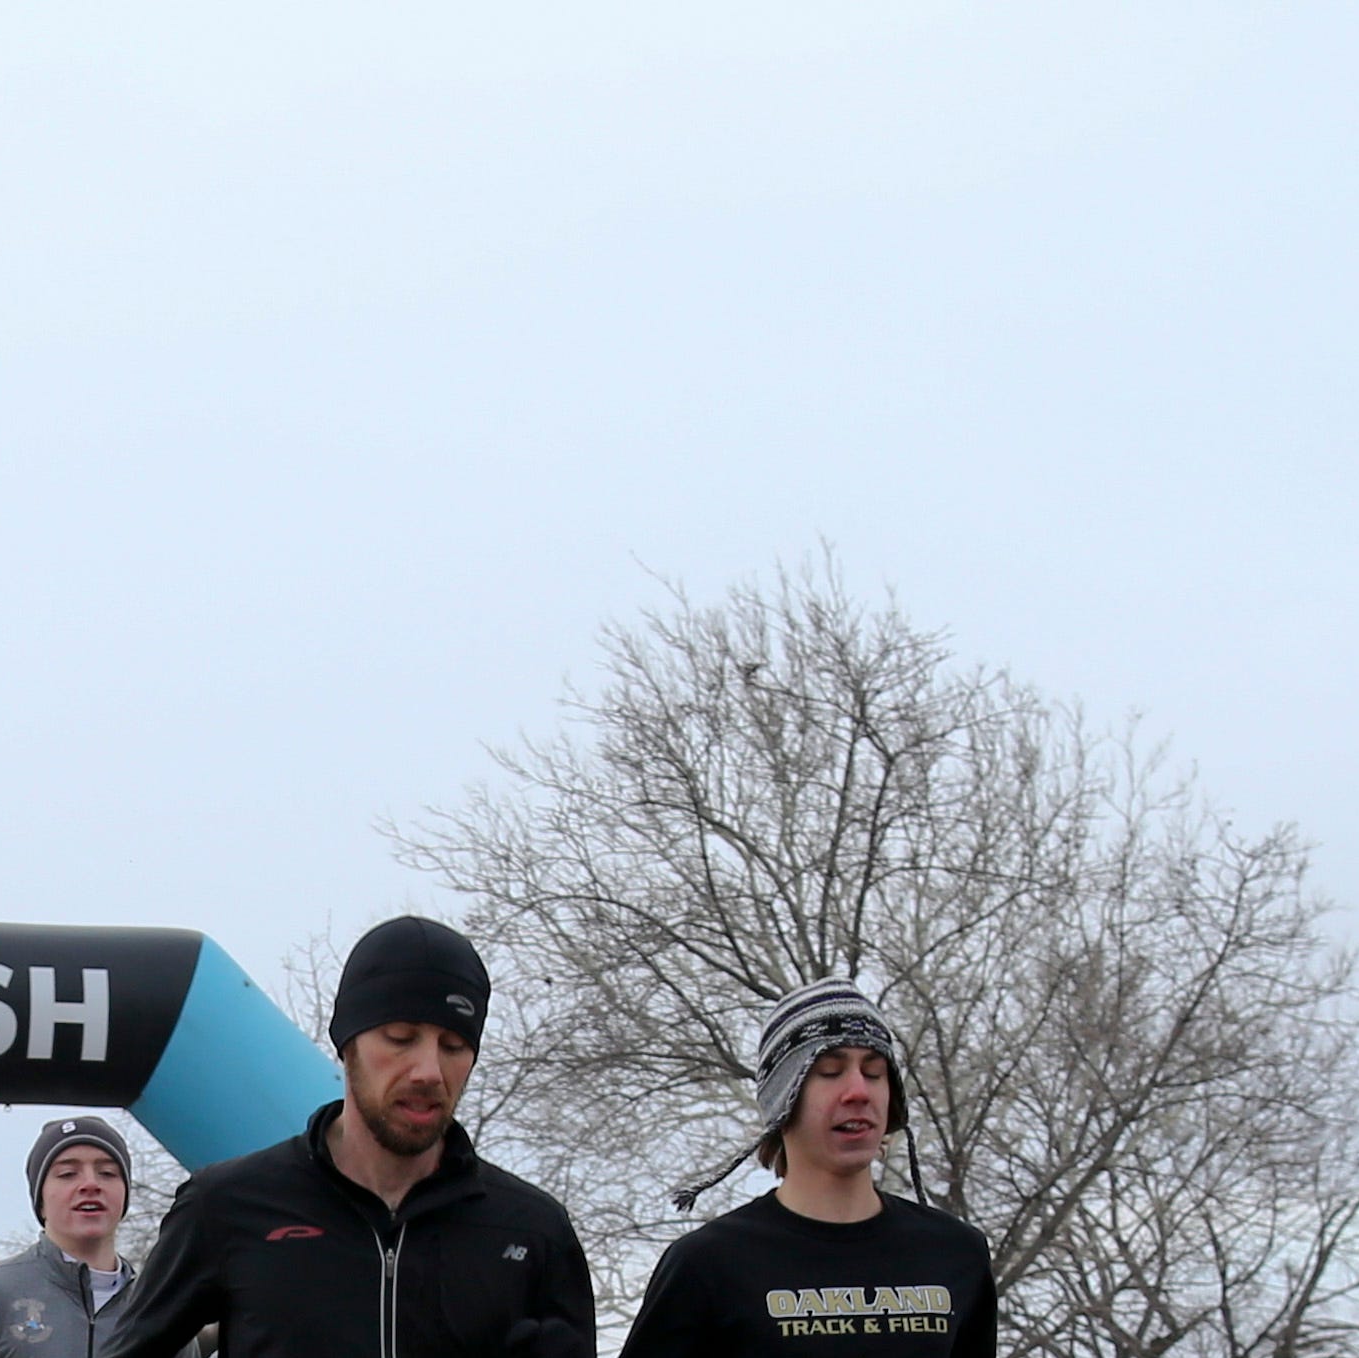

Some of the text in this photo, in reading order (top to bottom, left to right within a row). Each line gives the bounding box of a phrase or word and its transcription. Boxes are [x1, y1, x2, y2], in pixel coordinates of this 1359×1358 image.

[502, 1244, 527, 1261] NB
[766, 1285, 952, 1318] OAKLAND
[777, 1317, 948, 1336] TRACK & FIELD
